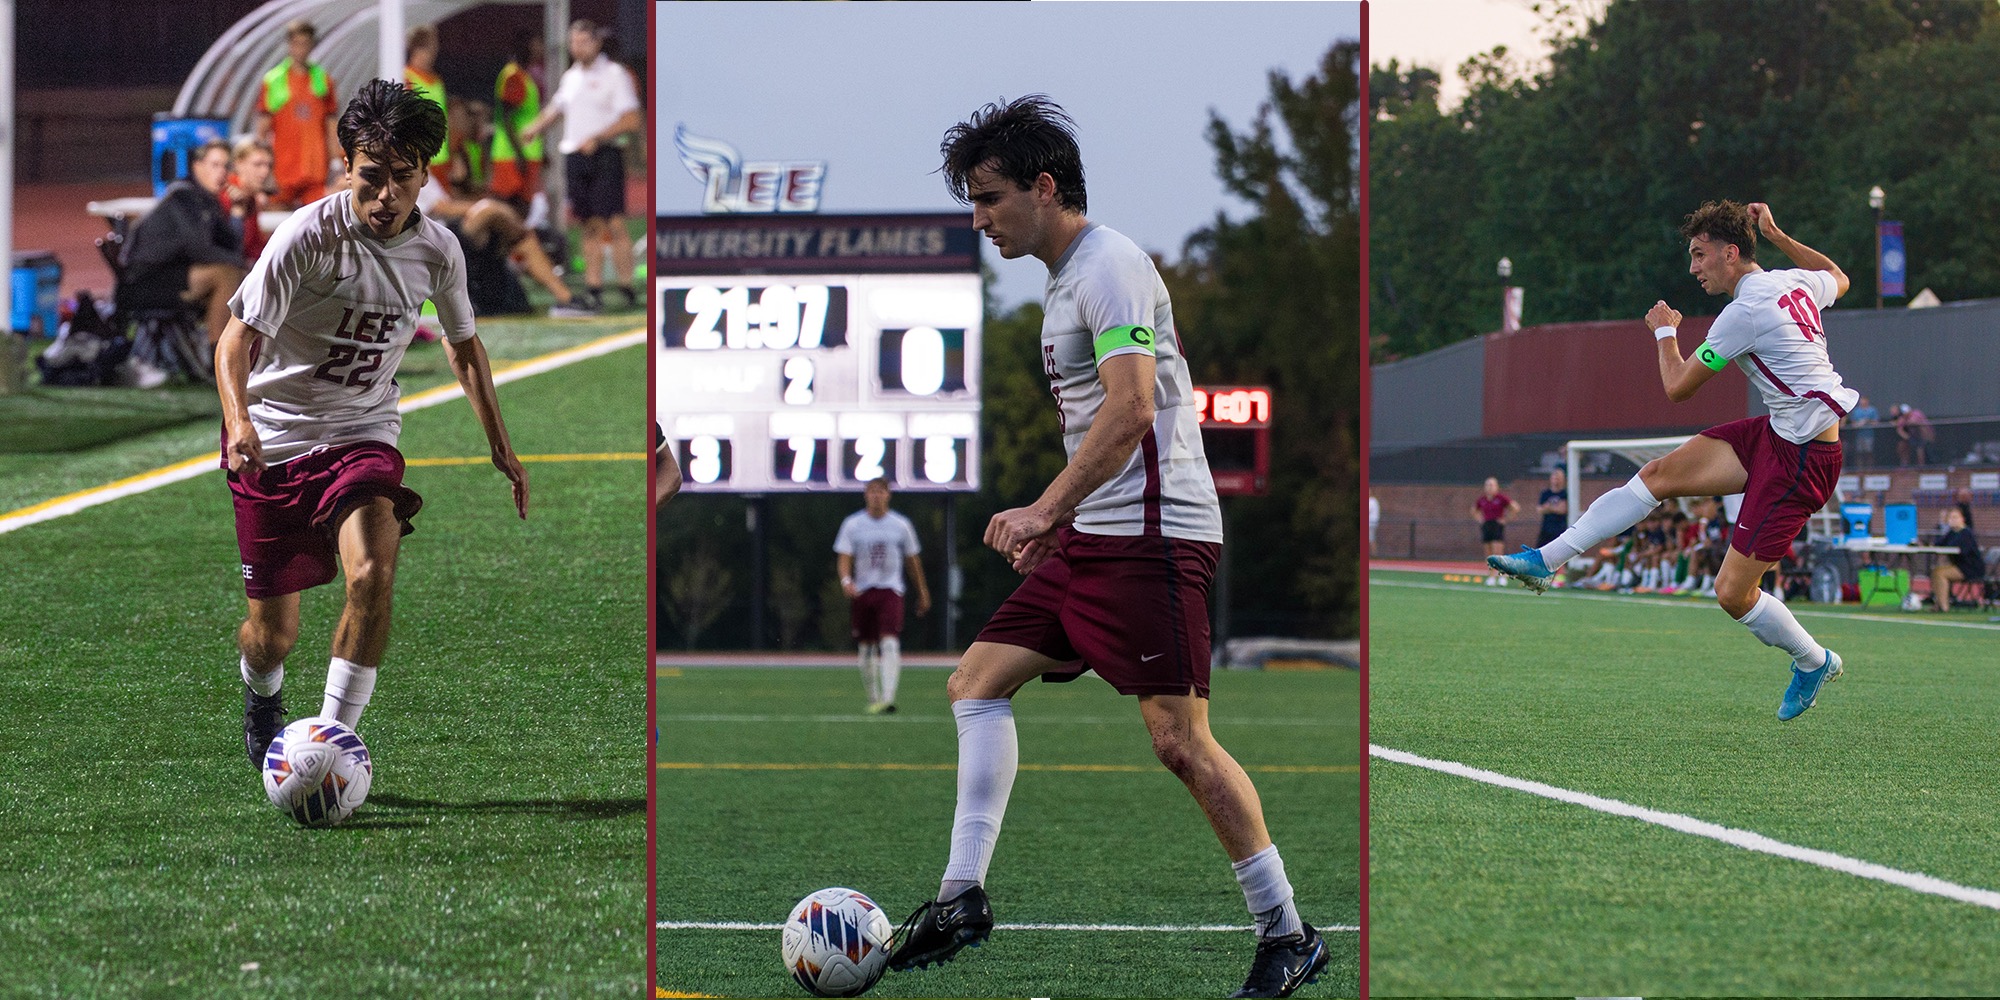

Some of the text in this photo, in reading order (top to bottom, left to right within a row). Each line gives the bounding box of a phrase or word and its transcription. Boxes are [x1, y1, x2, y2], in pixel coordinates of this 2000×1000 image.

[695, 156, 826, 213] LEE
[817, 227, 946, 256] FLAMES
[335, 307, 402, 343] LEE
[1130, 326, 1150, 344] C
[1777, 288, 1825, 342] 10
[313, 344, 384, 386] 22
[901, 326, 945, 395] 0
[1702, 349, 1715, 363] C
[784, 355, 813, 405] 2
[788, 435, 816, 482] 7
[854, 434, 885, 481] 2
